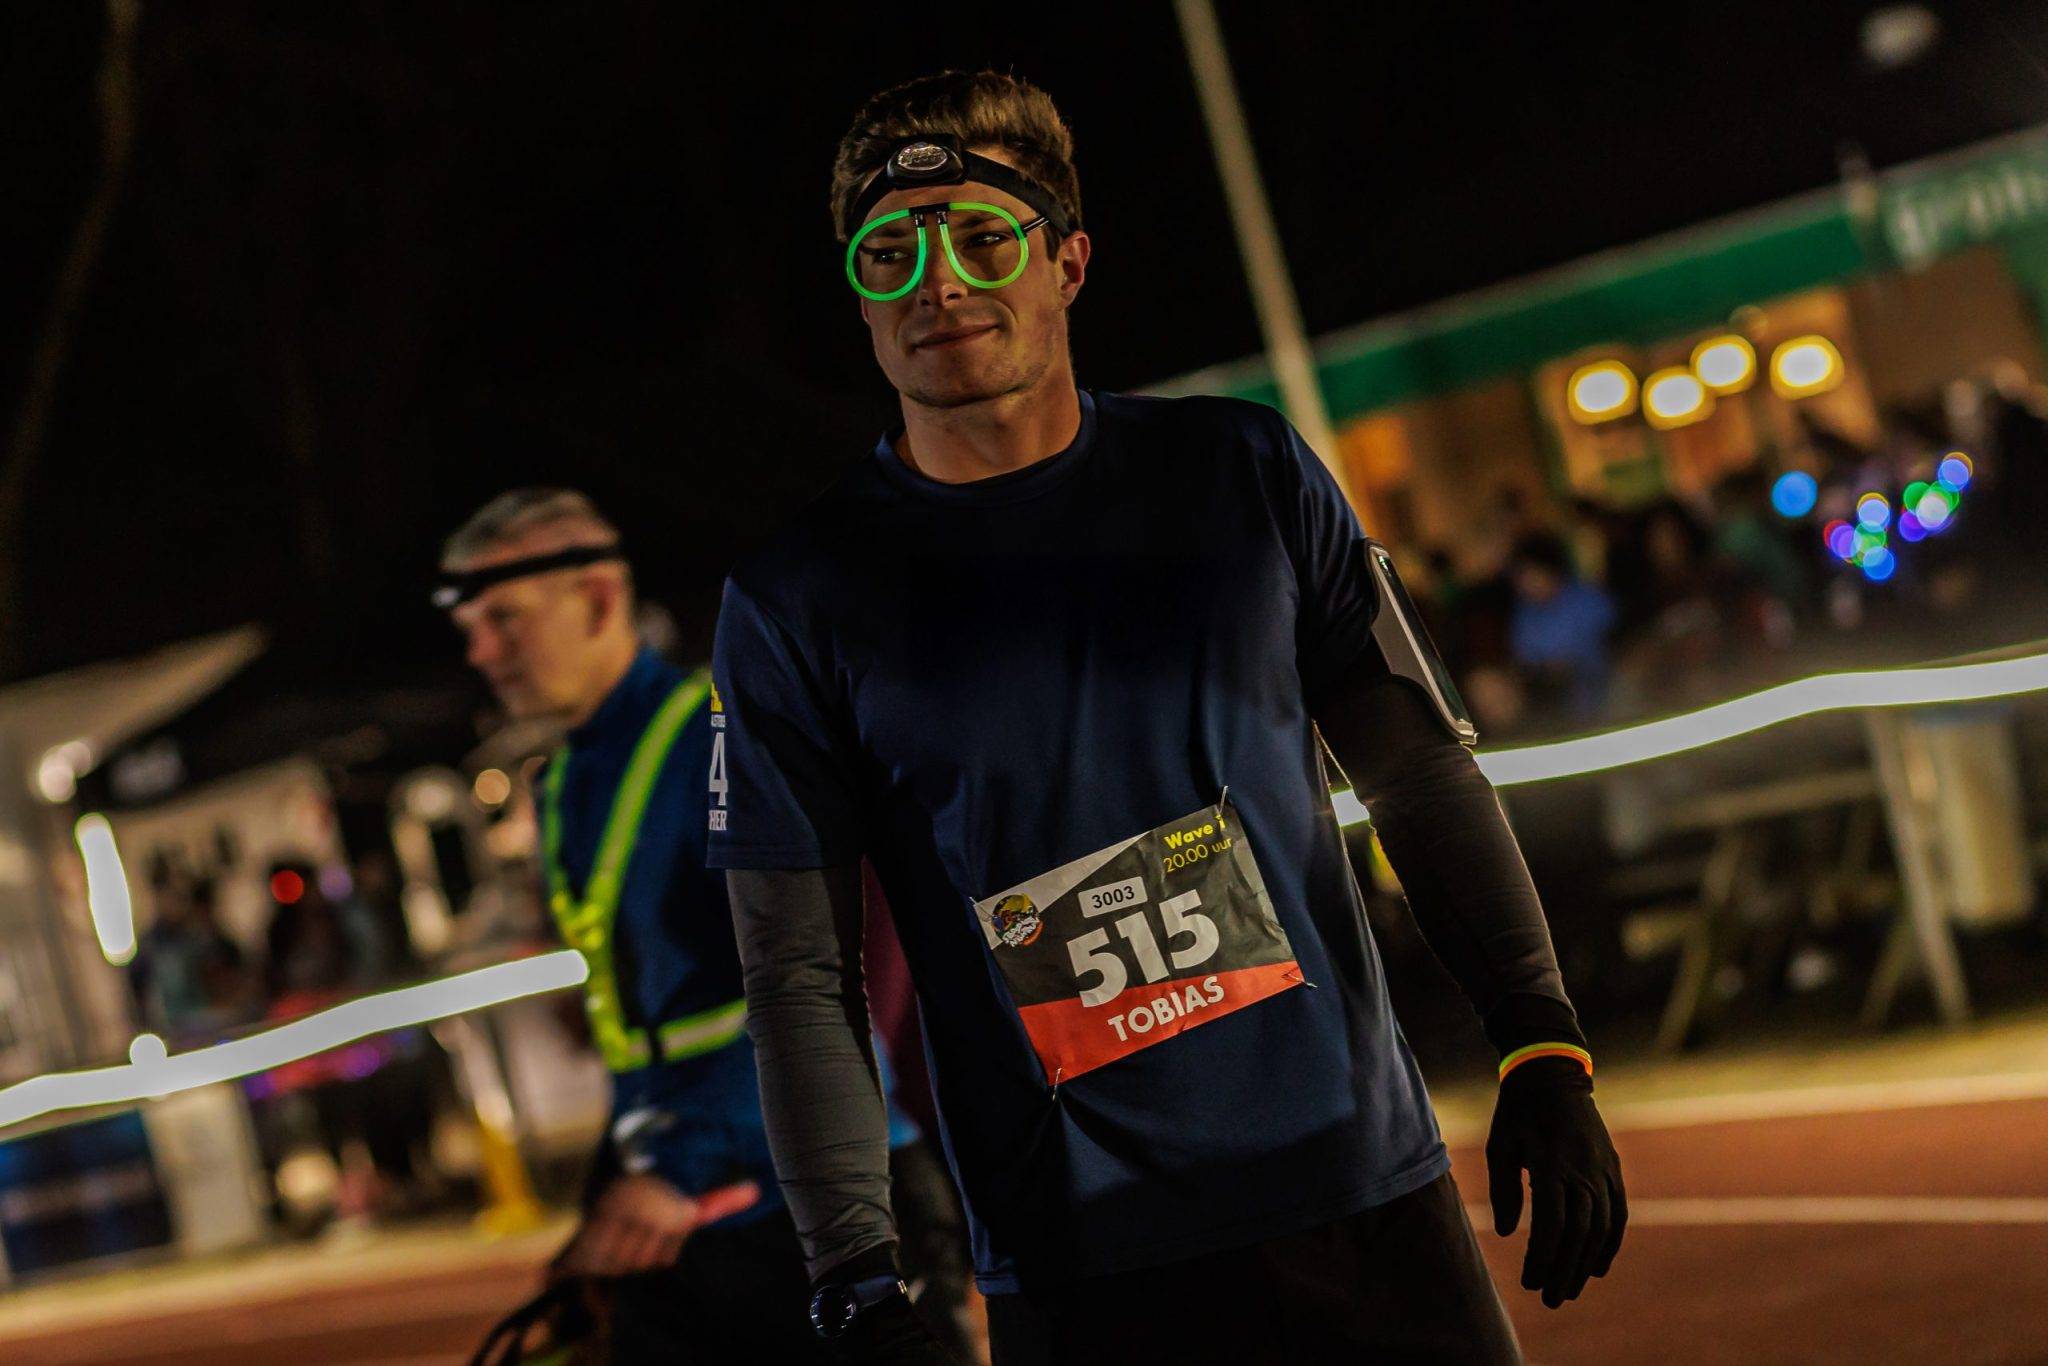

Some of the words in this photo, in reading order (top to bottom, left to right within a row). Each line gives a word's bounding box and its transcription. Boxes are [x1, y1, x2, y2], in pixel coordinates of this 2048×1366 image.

[708, 731, 728, 806] 4
[1163, 824, 1214, 849] Wave
[1163, 844, 1208, 872] 20.00
[1211, 838, 1232, 853] uur
[1091, 885, 1136, 909] 3003
[1066, 888, 1220, 1008] 515
[1107, 975, 1226, 1041] TOBIAS
